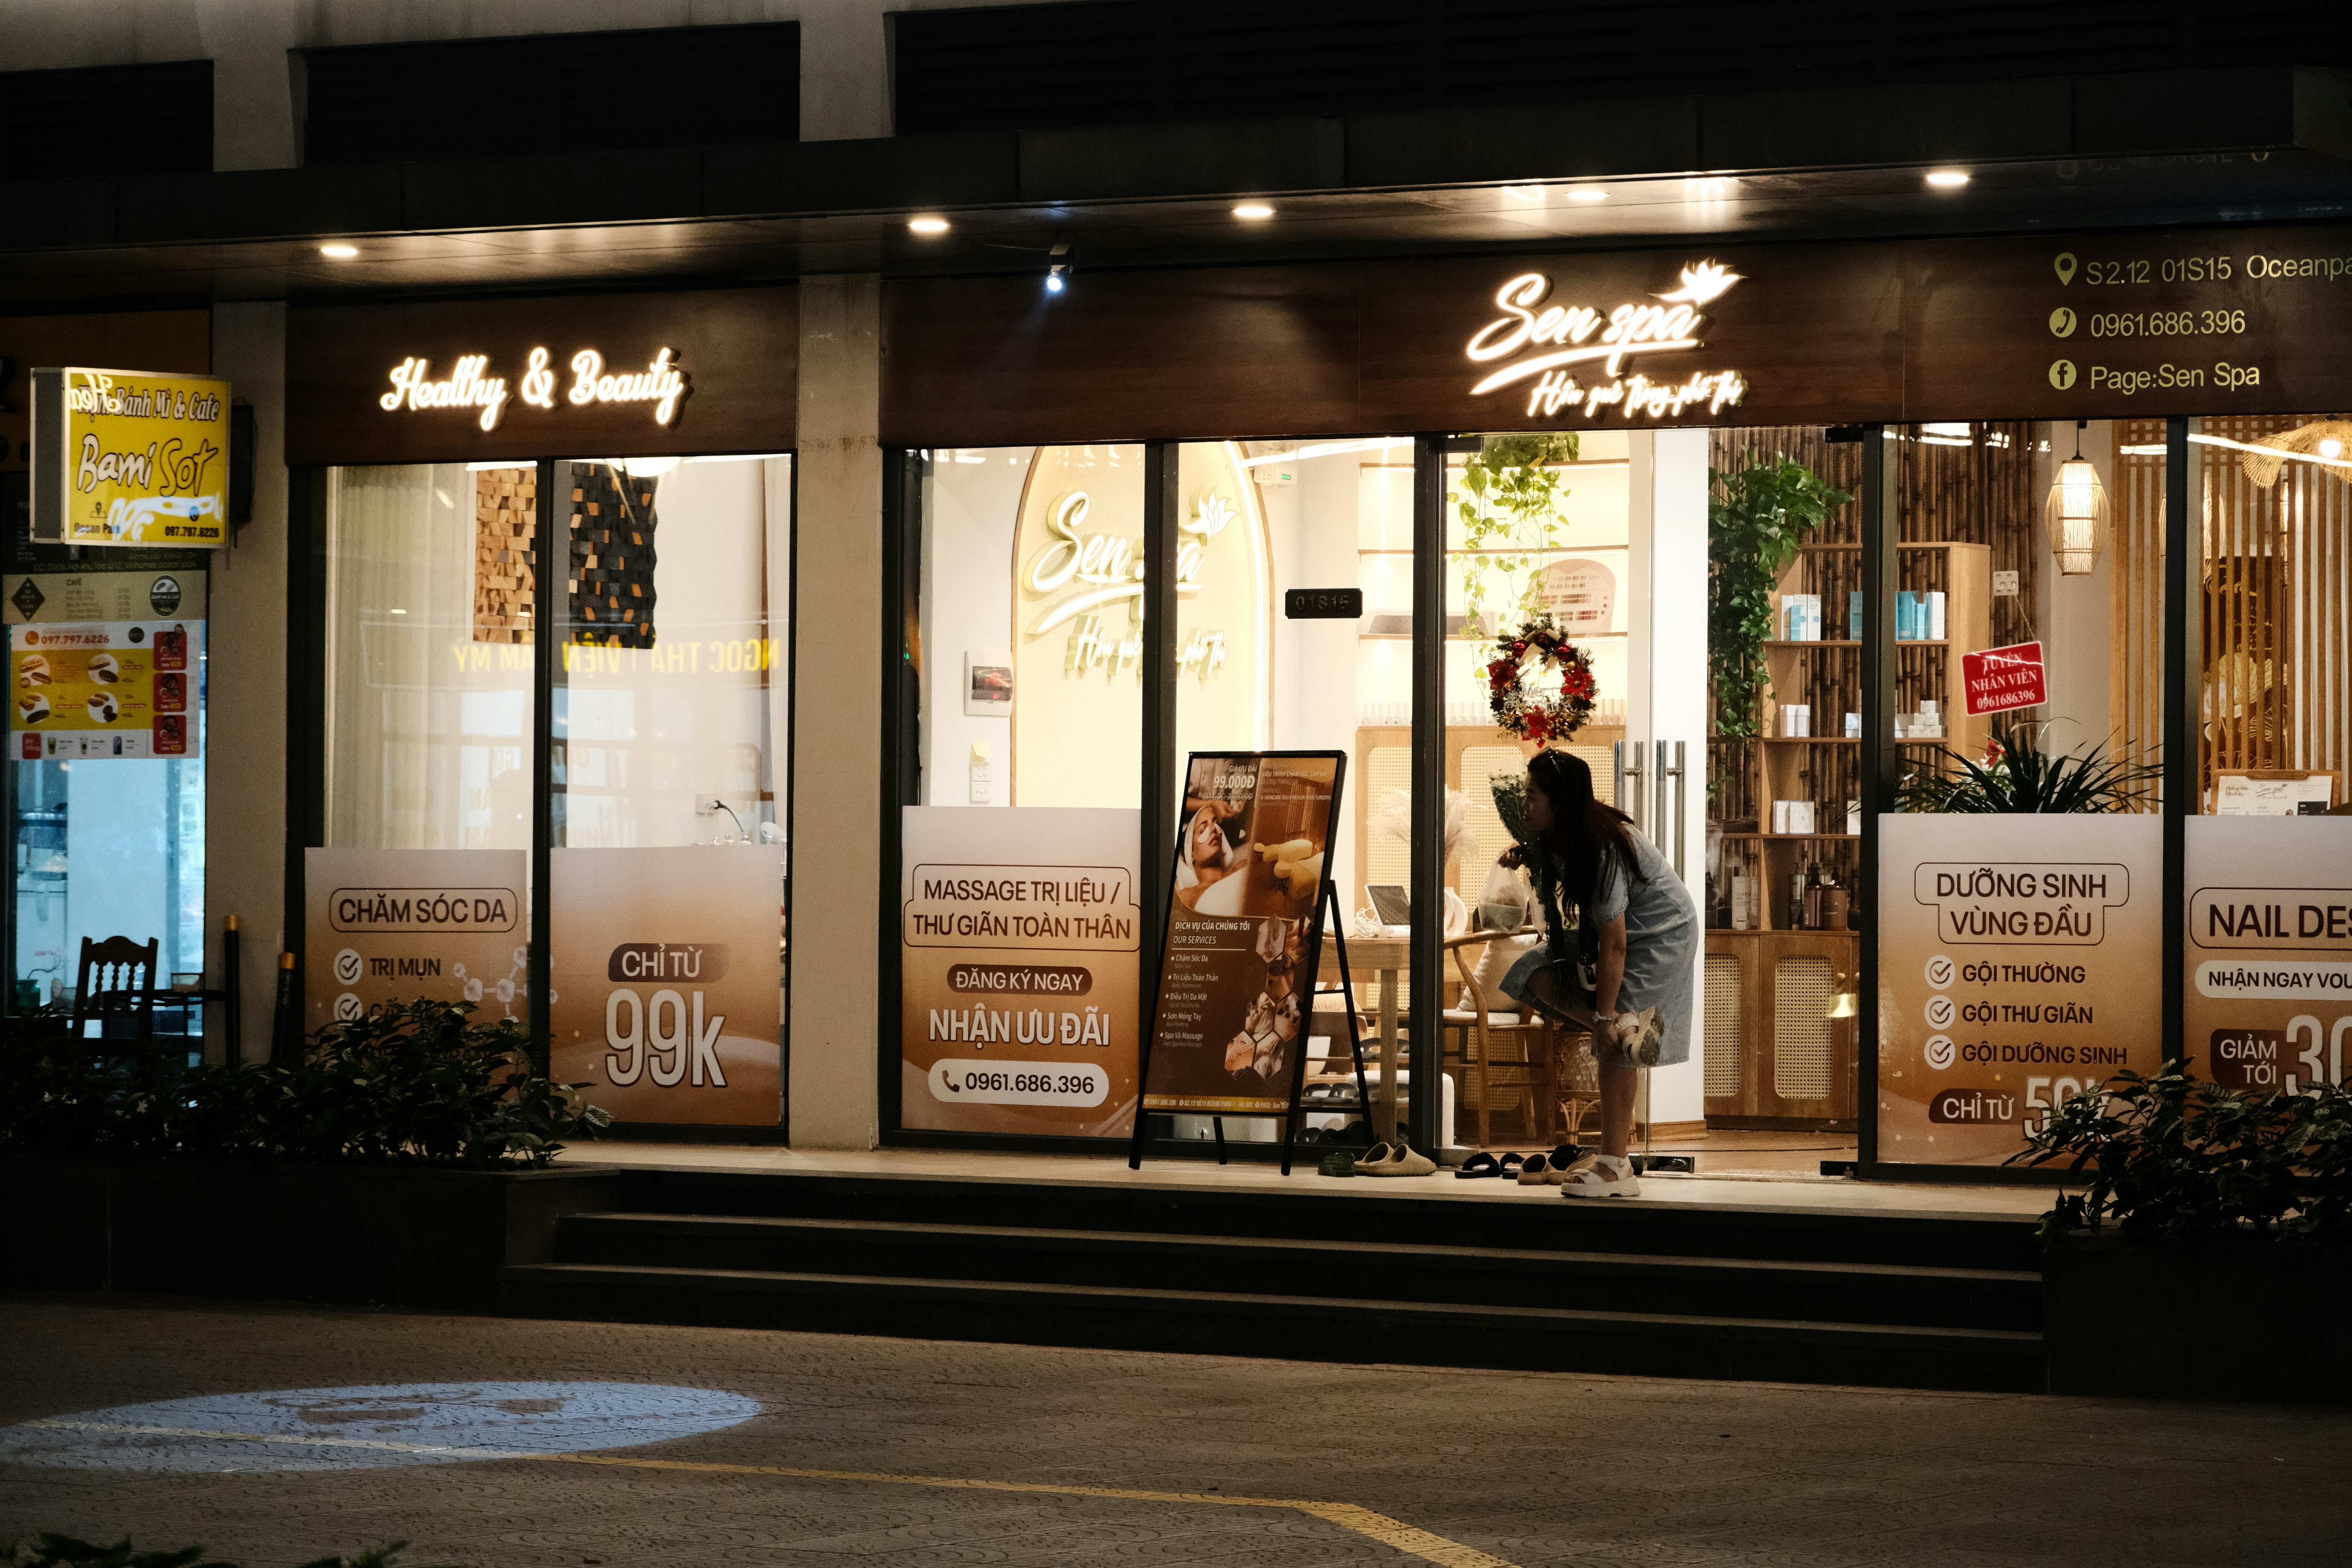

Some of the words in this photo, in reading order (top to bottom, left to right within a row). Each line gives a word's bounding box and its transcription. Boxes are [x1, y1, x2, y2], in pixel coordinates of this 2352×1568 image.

[2086, 260, 2150, 285] S2.12
[2162, 256, 2232, 282] 01S15
[1467, 273, 1601, 360] Sen
[1603, 304, 1701, 377] spa
[2091, 310, 2246, 338] 0961.686.396
[380, 355, 507, 431] Healthy
[522, 347, 554, 408] &
[569, 347, 684, 424] Beauty
[2091, 364, 2205, 395] Page:Sen
[2214, 362, 2260, 391] Spa
[174, 391, 186, 420] &
[189, 392, 220, 421] Cafe
[77, 433, 157, 493] Bami
[165, 526, 220, 538] 097.797.6226
[1031, 491, 1131, 593] Sen
[41, 634, 110, 644] 097.797.6226
[1971, 673, 2006, 692] NHÂN
[2008, 668, 2037, 685] VIÊN
[1977, 689, 2035, 710] 0961686396
[1213, 775, 1256, 789] 99.000Đ
[2255, 783, 2271, 793] Sen
[924, 880, 1026, 902] MASSAGE
[1031, 881, 1060, 906] TRỊ
[1066, 877, 1105, 907] LIỆU
[1110, 882, 1121, 904] /
[1937, 868, 2037, 897] DƯỠNG
[2042, 874, 2107, 899] SINH
[339, 893, 410, 923] CHĂM
[416, 893, 468, 923] SÓC
[474, 899, 507, 923] DA
[1951, 905, 2028, 936] VÙNG
[2034, 903, 2092, 937] ĐẦU
[914, 913, 955, 935] THƯ
[957, 911, 1008, 936] GIÃN
[1013, 912, 1069, 938] TOÀN
[1074, 914, 1130, 939] THÂN
[1175, 922, 1191, 932] DỊCH
[1192, 922, 1201, 932] VỤ
[1202, 920, 1214, 930] CỦA
[1215, 920, 1238, 930] CHÚNG
[1239, 920, 1251, 931] TÔI
[2210, 904, 2290, 938] NAIL
[2299, 905, 2352, 939] DE
[1173, 936, 1187, 944] OUR
[1187, 936, 1217, 944] SERVICES
[369, 958, 395, 980] TRỊ
[399, 958, 441, 980] MỤN
[622, 943, 665, 977] CHỈ
[670, 946, 702, 978] TỪ
[956, 968, 1006, 989] ĐĂNG
[1010, 969, 1031, 990] KÝ
[1034, 973, 1083, 991] NGAY
[1180, 973, 1191, 983] Liệu
[1962, 961, 1997, 986] GỘI
[2001, 962, 2086, 983] THƯỜNG
[2208, 968, 2260, 991] NHẬN
[2263, 972, 2314, 988] NGAY
[1197, 992, 1208, 1002] Mặt
[1178, 1012, 1192, 1021] Móng
[1193, 1013, 1202, 1022] Tay
[1962, 1001, 1997, 1026] GỘI
[2001, 1003, 2041, 1023] THƯ
[2043, 1002, 2093, 1024] GIÃN
[605, 988, 728, 1087] 99k
[929, 1003, 1011, 1050] NHẬN
[1017, 1008, 1055, 1044] ƯU
[1060, 1006, 1110, 1046] ĐÃI
[1164, 1032, 1174, 1040] Spa
[1182, 1032, 1204, 1041] Massage
[1962, 1041, 1997, 1066] GỘI
[2002, 1041, 2075, 1064] DƯỠNG
[2080, 1047, 2127, 1065] SINH
[2220, 1034, 2277, 1060] GIẢM
[965, 1072, 1095, 1094] 0961.686.396
[2243, 1060, 2277, 1085] TỚI
[1943, 1092, 1981, 1119] CHỈ
[1986, 1094, 2015, 1121] TỪ
